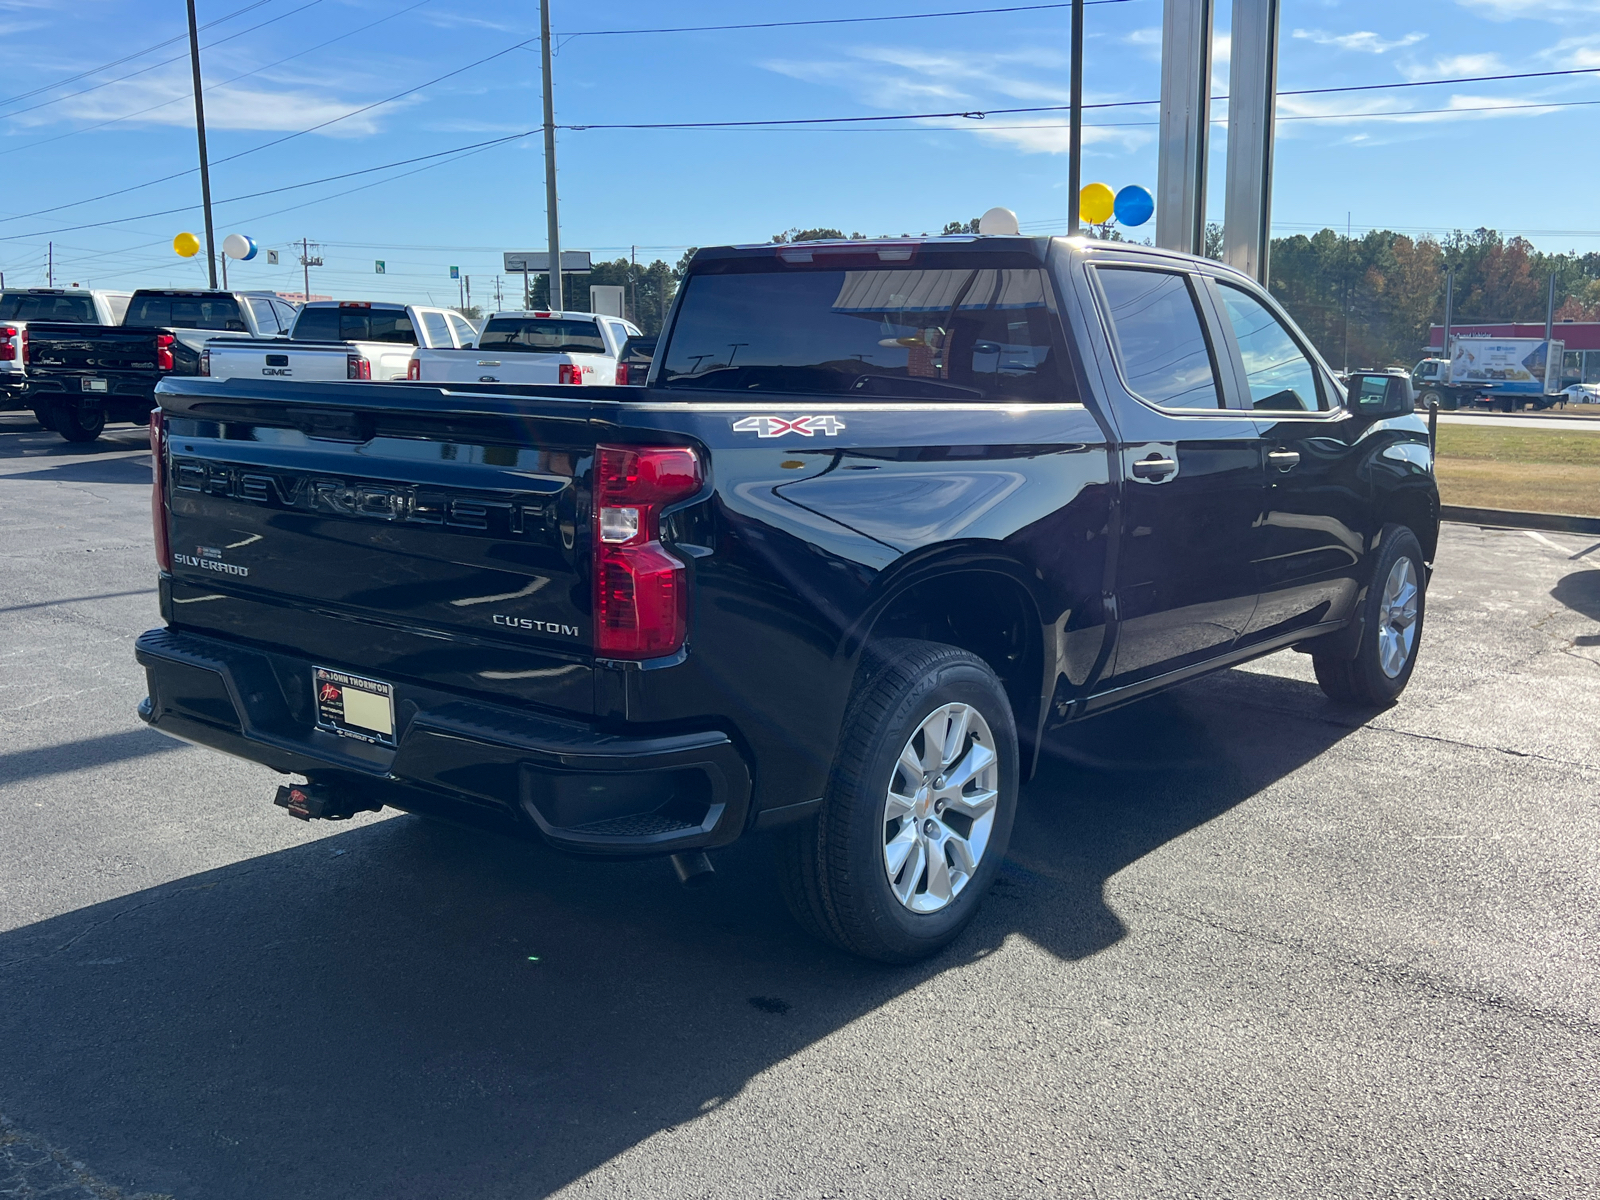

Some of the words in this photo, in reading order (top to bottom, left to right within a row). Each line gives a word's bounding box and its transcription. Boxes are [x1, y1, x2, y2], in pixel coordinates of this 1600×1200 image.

[262, 368, 292, 376] GMC
[174, 462, 553, 534] CHEVROLET
[174, 553, 249, 577] SILVERADO
[492, 614, 579, 637] CUSTOM
[330, 673, 349, 683] JOHN
[349, 678, 388, 693] THORNTON
[896, 677, 934, 722] ALENZA
